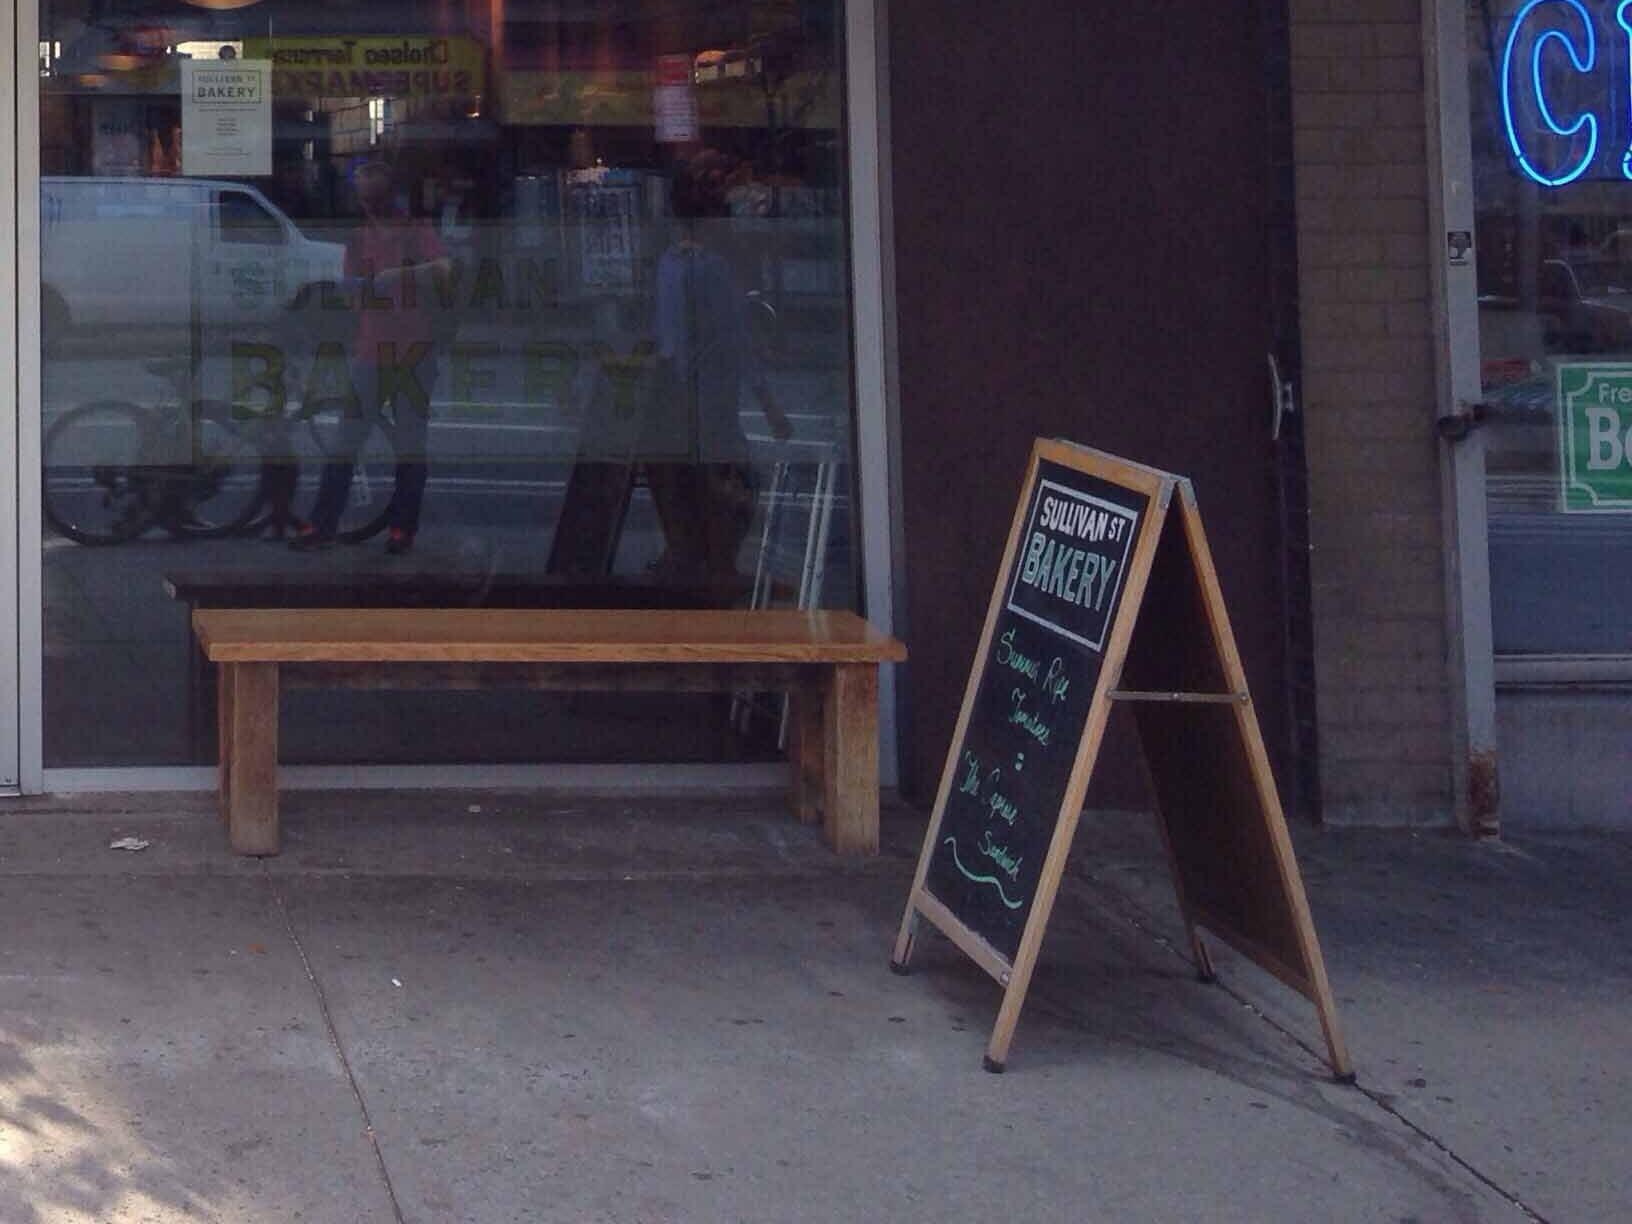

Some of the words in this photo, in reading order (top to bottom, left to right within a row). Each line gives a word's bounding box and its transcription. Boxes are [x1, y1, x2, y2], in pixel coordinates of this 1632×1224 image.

[197, 86, 256, 98] BAKERY
[230, 257, 560, 312] SULLIVAN
[229, 340, 660, 422] BAKERY
[1585, 407, 1632, 470] B
[1040, 496, 1109, 542] SULLIVAN
[1108, 517, 1126, 542] ST
[1021, 531, 1117, 612] BAKERY
